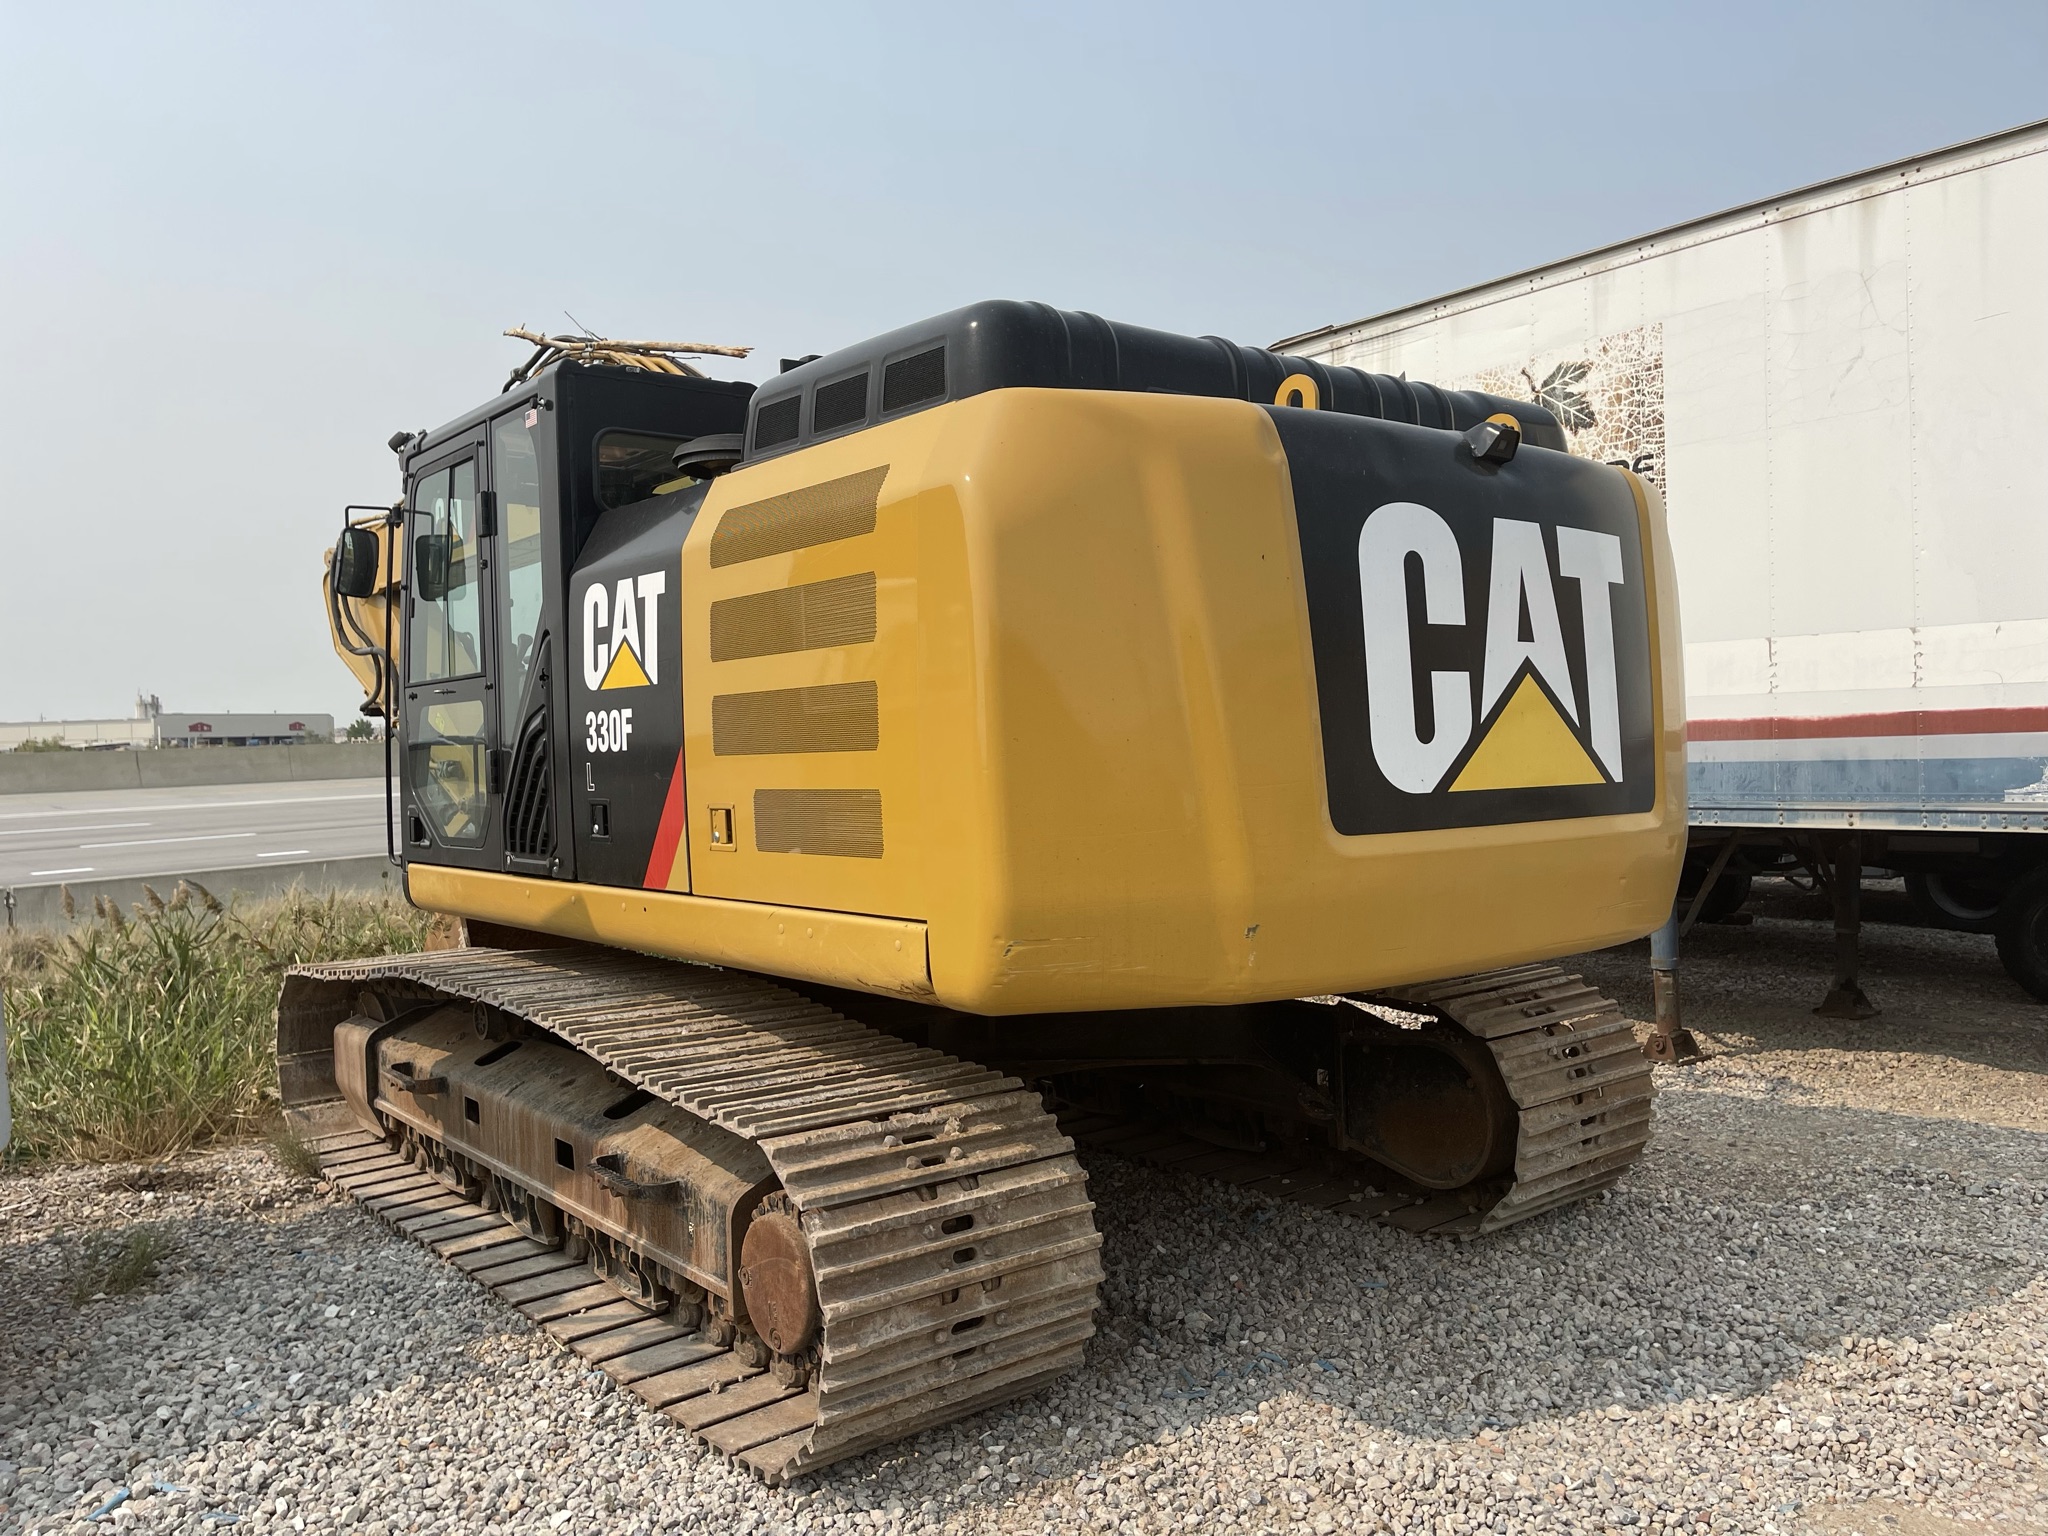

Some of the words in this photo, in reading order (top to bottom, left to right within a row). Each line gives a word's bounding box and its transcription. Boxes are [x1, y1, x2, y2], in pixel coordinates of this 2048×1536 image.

[583, 570, 666, 691] CAT
[1358, 502, 1624, 794] CAT
[585, 708, 633, 753] 330F
